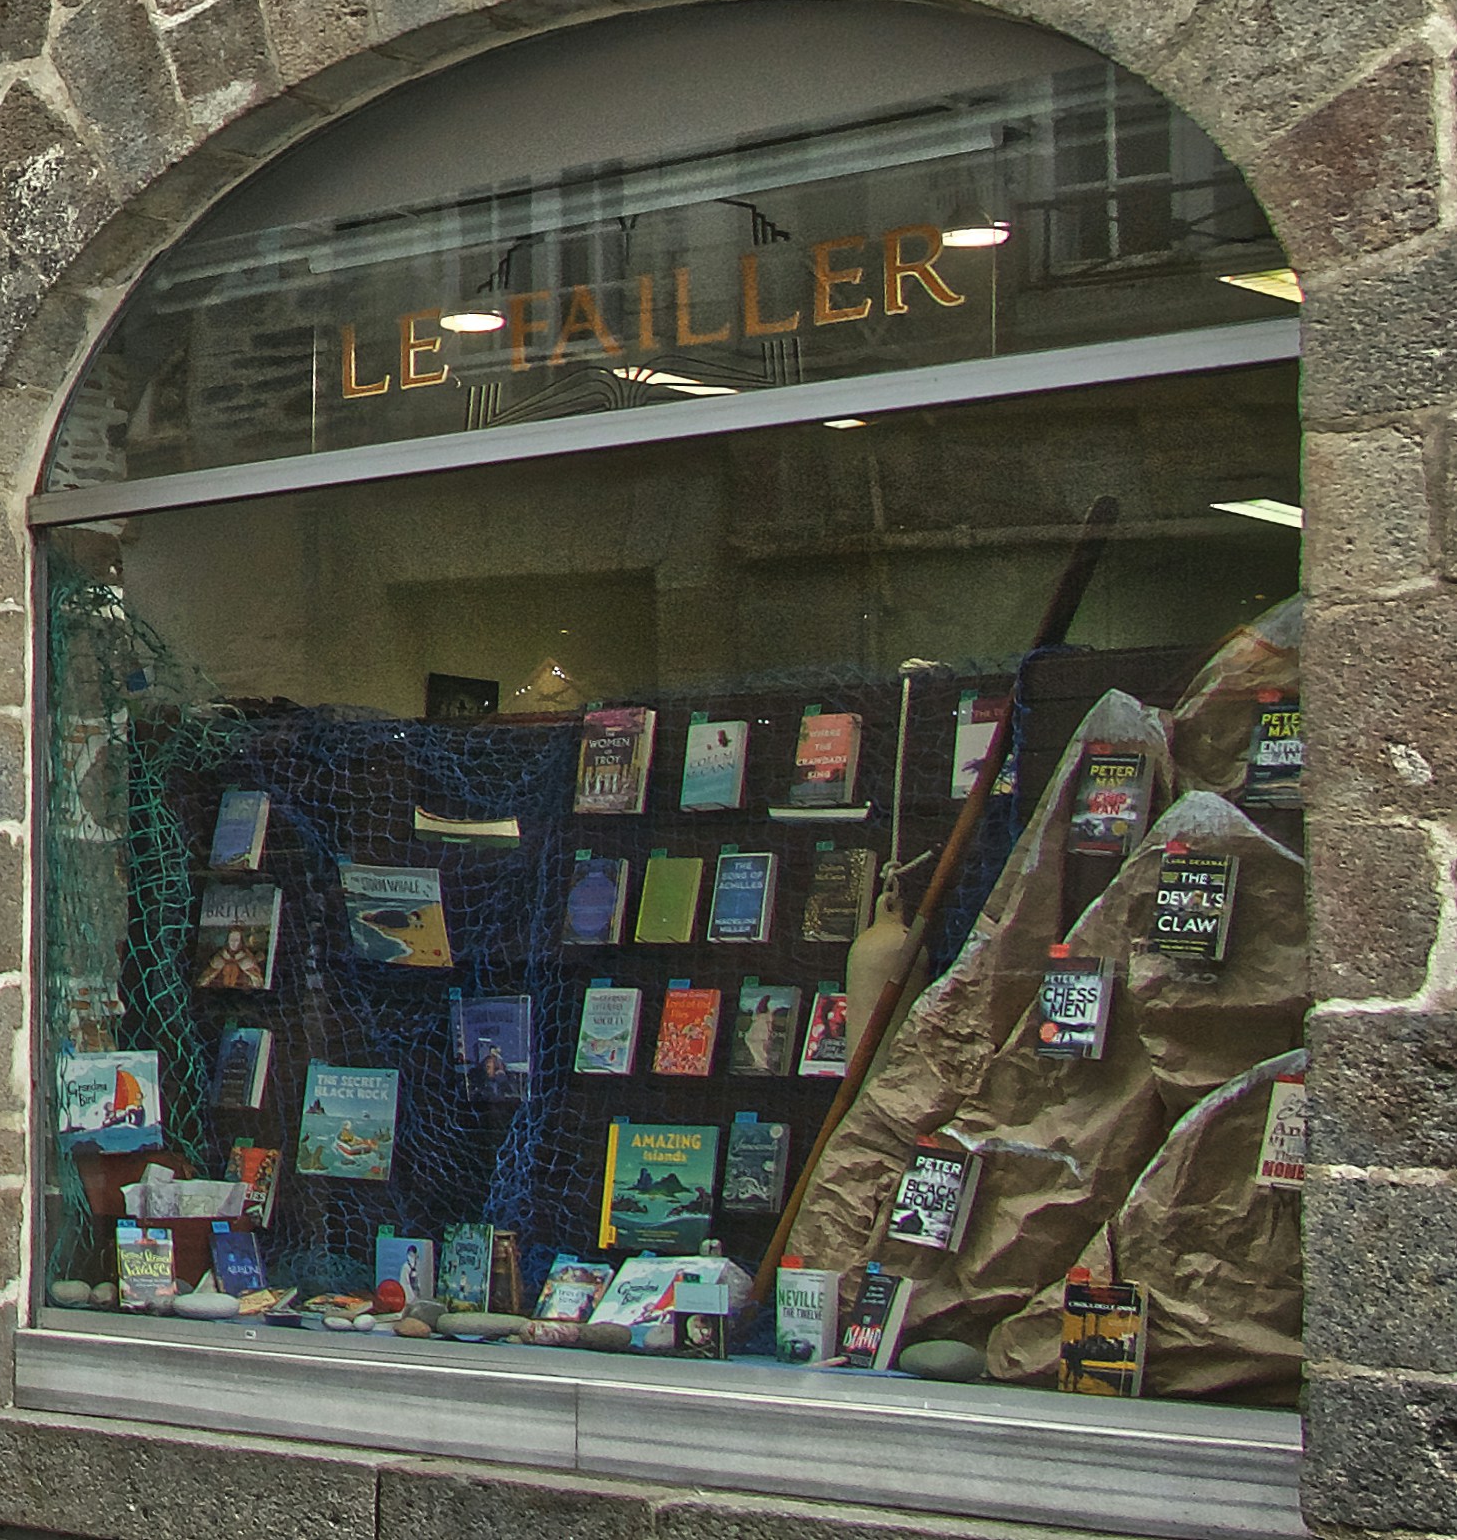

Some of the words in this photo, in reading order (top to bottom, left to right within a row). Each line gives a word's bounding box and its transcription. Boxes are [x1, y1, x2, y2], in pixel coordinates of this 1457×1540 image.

[340, 307, 449, 399] LE
[507, 223, 966, 372] FAILLER
[1261, 713, 1301, 725] PETE
[1268, 724, 1301, 737] MAY
[589, 738, 630, 748] WOMEN
[594, 755, 622, 765] TROY
[1090, 764, 1135, 777] PETER
[734, 862, 752, 870] THE
[388, 878, 420, 893] WHALE
[1181, 871, 1208, 884] THE
[718, 882, 764, 890] ACHILLES
[1157, 890, 1225, 908] DEVL'S
[1157, 915, 1217, 933] CLAW
[1043, 987, 1098, 1004] CHESS
[1049, 1001, 1087, 1018] MEN
[67, 1080, 107, 1097] Grandma
[317, 1074, 338, 1085] THE
[341, 1075, 383, 1088] SECRET
[78, 1090, 96, 1107] Bird
[314, 1086, 355, 1099] BLACK
[357, 1089, 389, 1100] ROCK
[631, 1133, 702, 1150] AMAZING
[916, 1156, 963, 1175] PETER
[906, 1179, 960, 1201] BLACK
[902, 1191, 957, 1213] HOUSE
[778, 1290, 826, 1310] NEVILLE
[783, 1306, 796, 1319] THE
